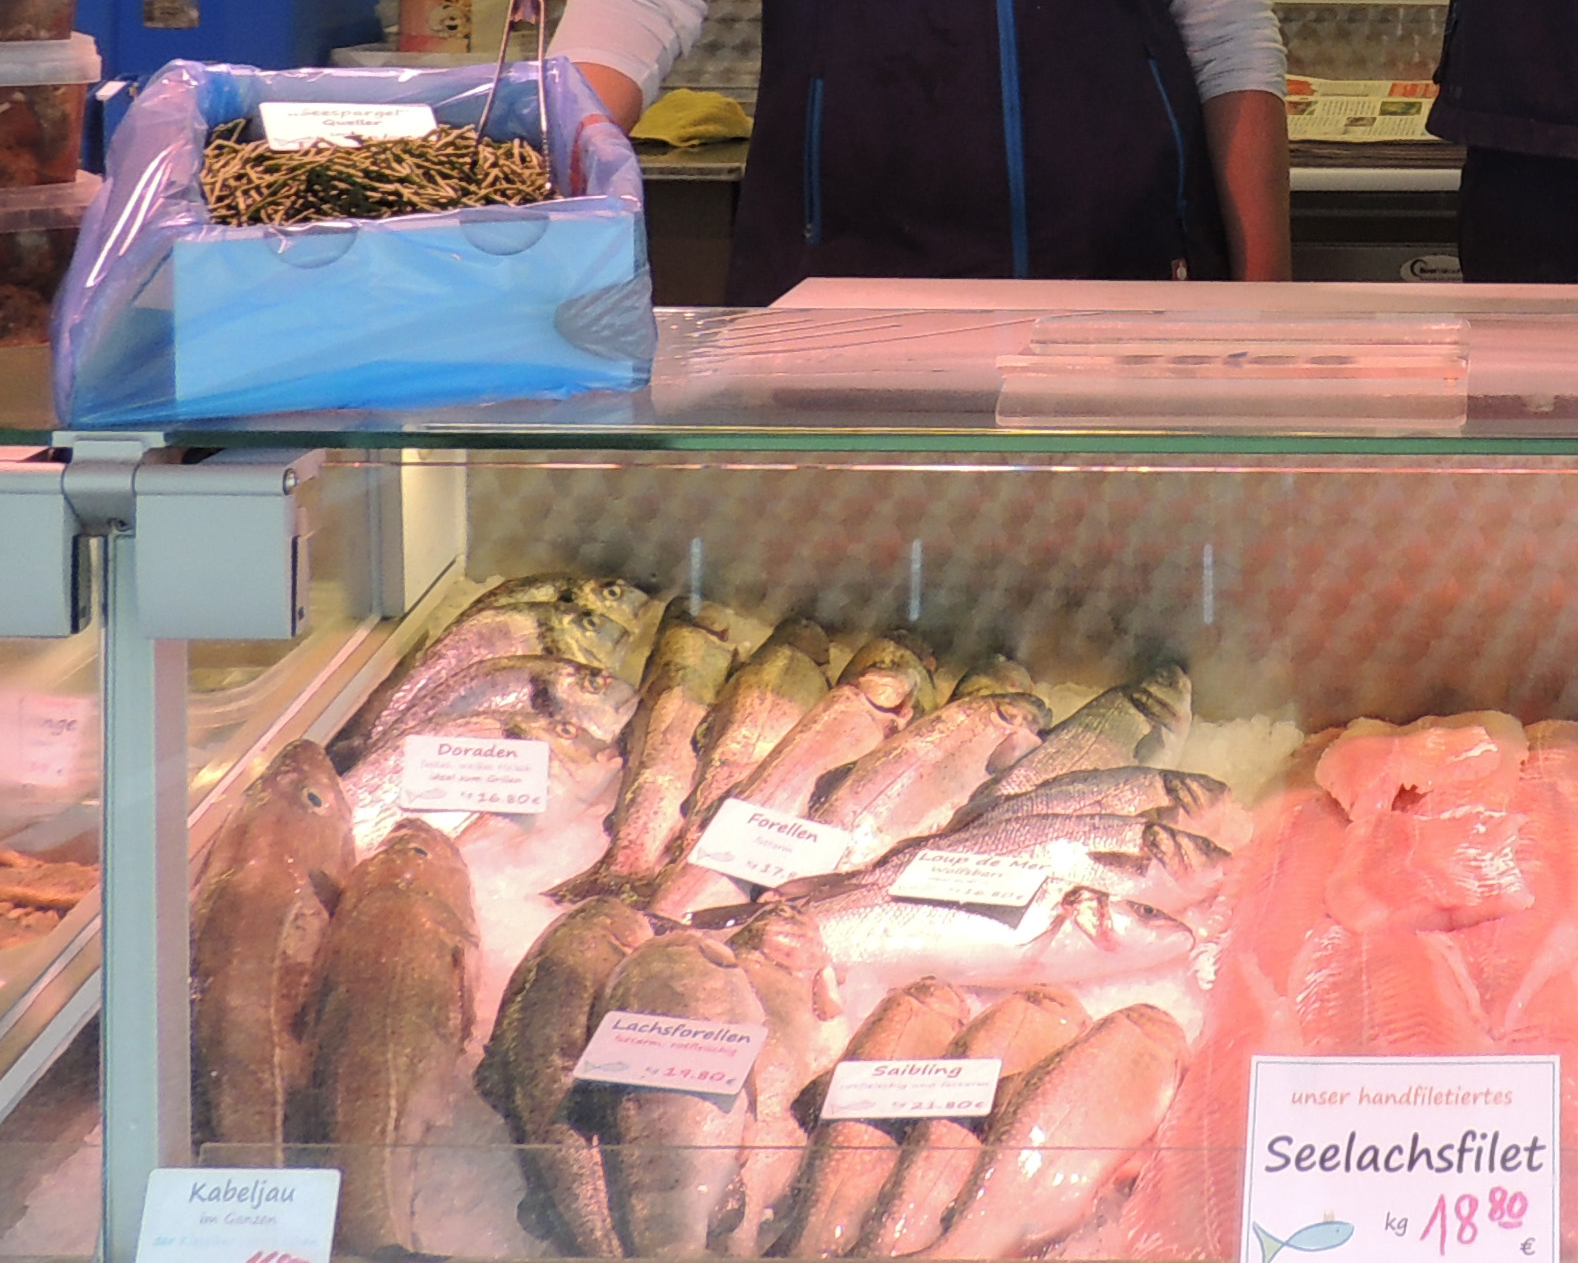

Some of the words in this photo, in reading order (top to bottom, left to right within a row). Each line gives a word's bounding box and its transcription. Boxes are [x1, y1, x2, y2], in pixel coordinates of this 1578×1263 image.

[437, 743, 518, 758] Doraden
[747, 812, 818, 843] Forellen
[918, 852, 969, 866] Loup
[975, 855, 1001, 867] de
[1008, 860, 1052, 870] Mer
[612, 1019, 751, 1044] Lachsforellen
[872, 1064, 963, 1079] Saibling
[1291, 1088, 1351, 1105] unser
[1358, 1086, 1513, 1106] handfiletiertes
[1264, 1129, 1547, 1173] Seelachsfilet
[188, 1178, 296, 1210] Kabeljau
[200, 1212, 219, 1224] im
[223, 1212, 277, 1225] Ganzen
[1384, 1211, 1408, 1237] kg
[1519, 1237, 1537, 1256] €
